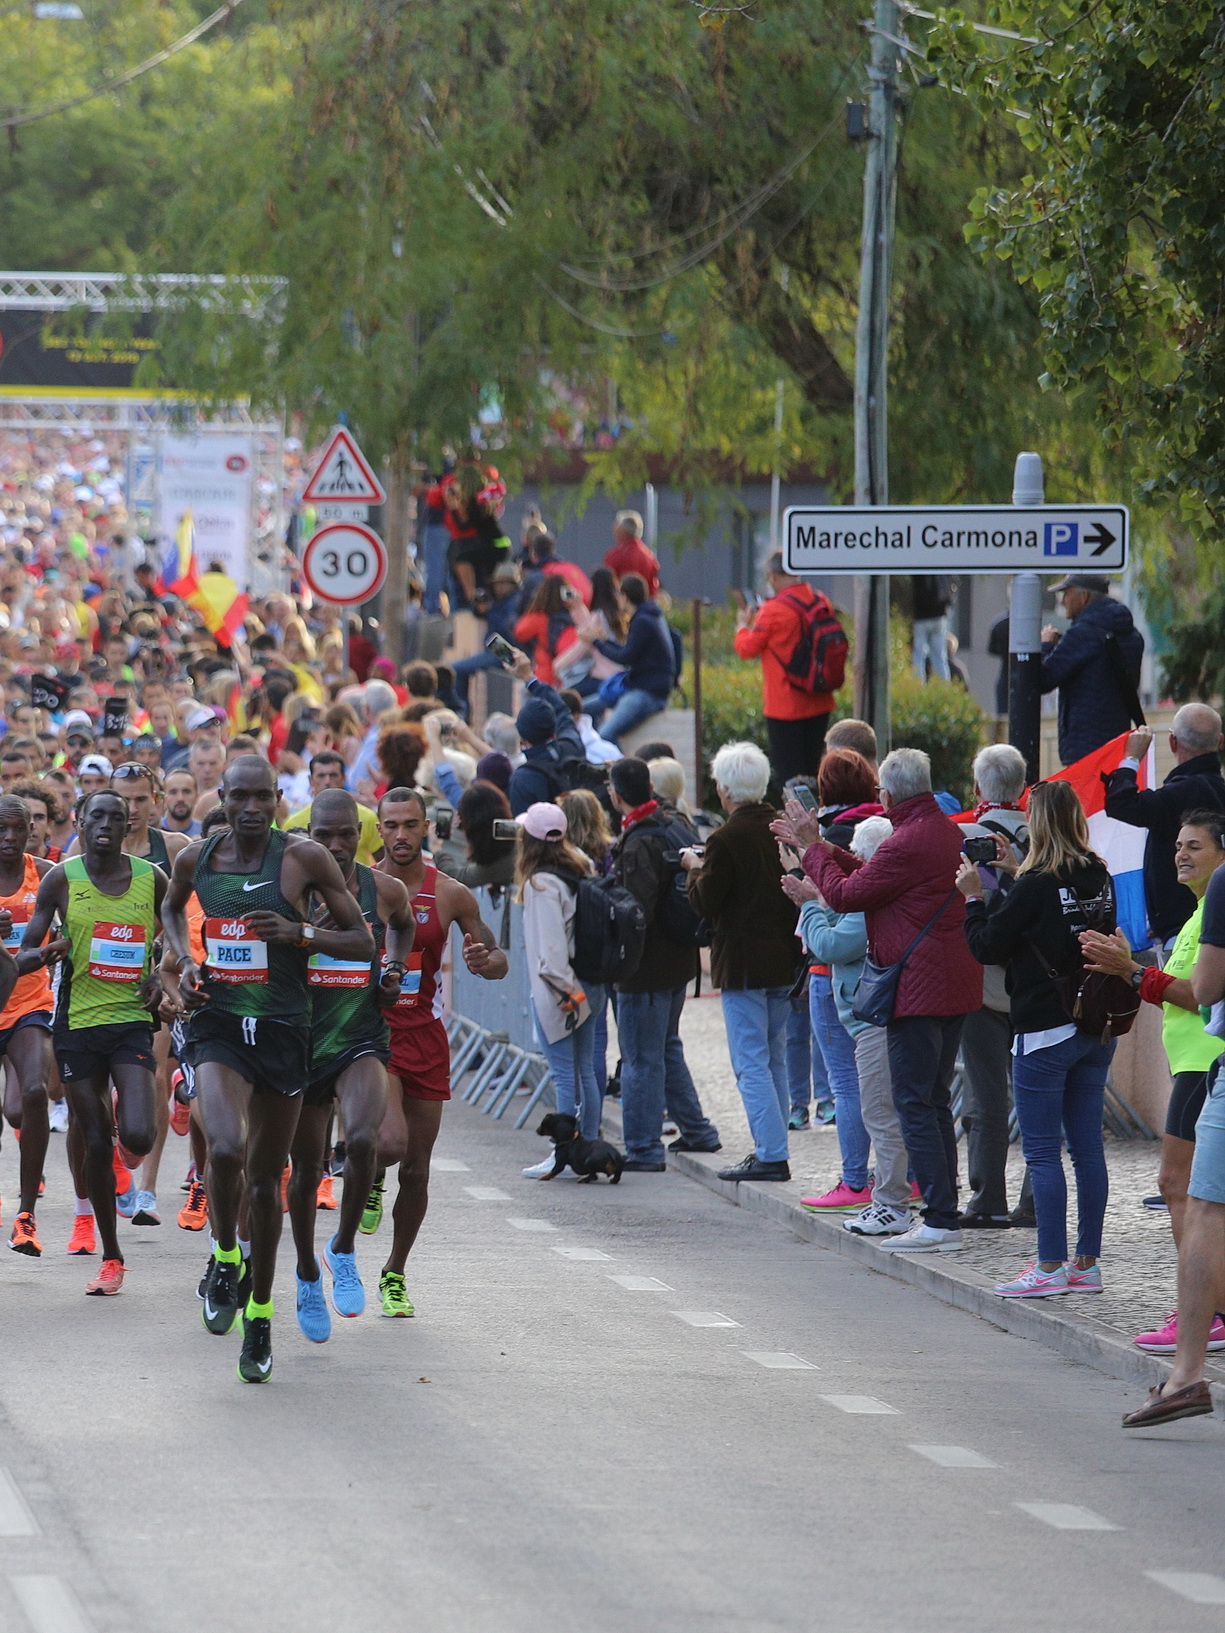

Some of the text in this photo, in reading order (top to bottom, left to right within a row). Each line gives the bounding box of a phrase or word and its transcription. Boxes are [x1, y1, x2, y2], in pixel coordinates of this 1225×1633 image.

[796, 523, 1071, 555] Marechal Carmona P
[321, 551, 367, 578] 30
[110, 925, 133, 942] edp
[221, 920, 246, 940] edp
[217, 946, 251, 962] PACE
[101, 969, 139, 980] Santander
[221, 972, 265, 982] Santander
[322, 975, 366, 984] Santander
